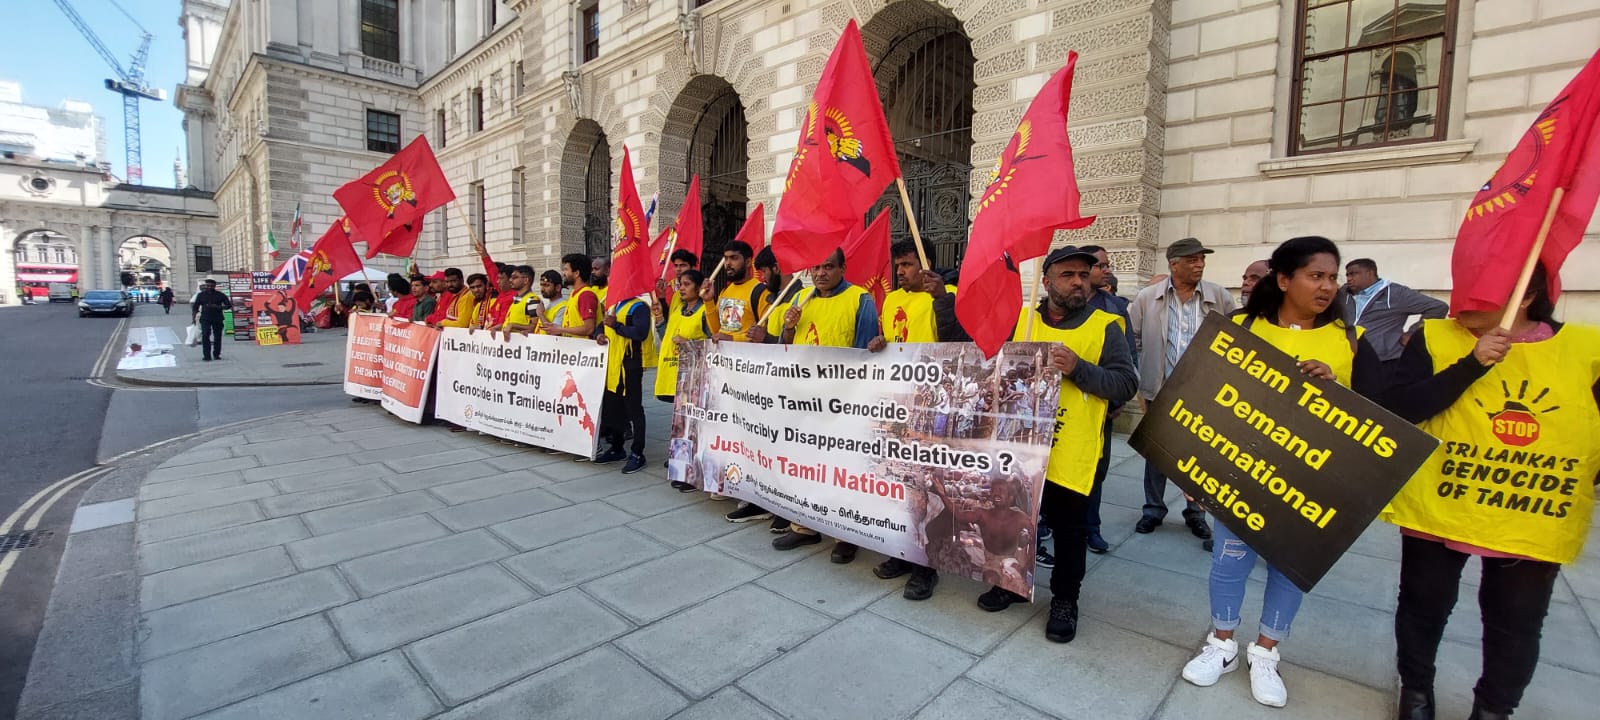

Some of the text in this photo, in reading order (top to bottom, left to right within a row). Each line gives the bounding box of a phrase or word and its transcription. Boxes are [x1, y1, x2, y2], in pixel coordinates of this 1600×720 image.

[526, 345, 605, 369] Tamileelam!
[735, 358, 765, 375] Eelam
[765, 361, 812, 379] Tamils
[817, 363, 867, 380] killed
[872, 364, 885, 380] in
[889, 364, 940, 383] 2009
[494, 369, 542, 390] ongoing
[1209, 331, 1398, 459] Eelam Tamils
[493, 388, 504, 404] in
[507, 390, 579, 418] Tamileelam
[778, 395, 823, 412] Tamil
[828, 399, 908, 421] Genocide
[707, 410, 729, 423] are
[784, 427, 881, 456] Disappeared
[887, 440, 990, 470] Relatives
[998, 453, 1014, 473] ?
[1214, 383, 1332, 471] Demand
[1495, 419, 1538, 438] STOP
[710, 435, 905, 501] Justice for Tamil Nation
[1168, 398, 1337, 529] International
[1445, 441, 1580, 472] SRI LANKA'S
[1176, 455, 1266, 532] Justice
[1441, 459, 1578, 496] GENOCIDE
[1437, 481, 1572, 519] OF TAMILS
